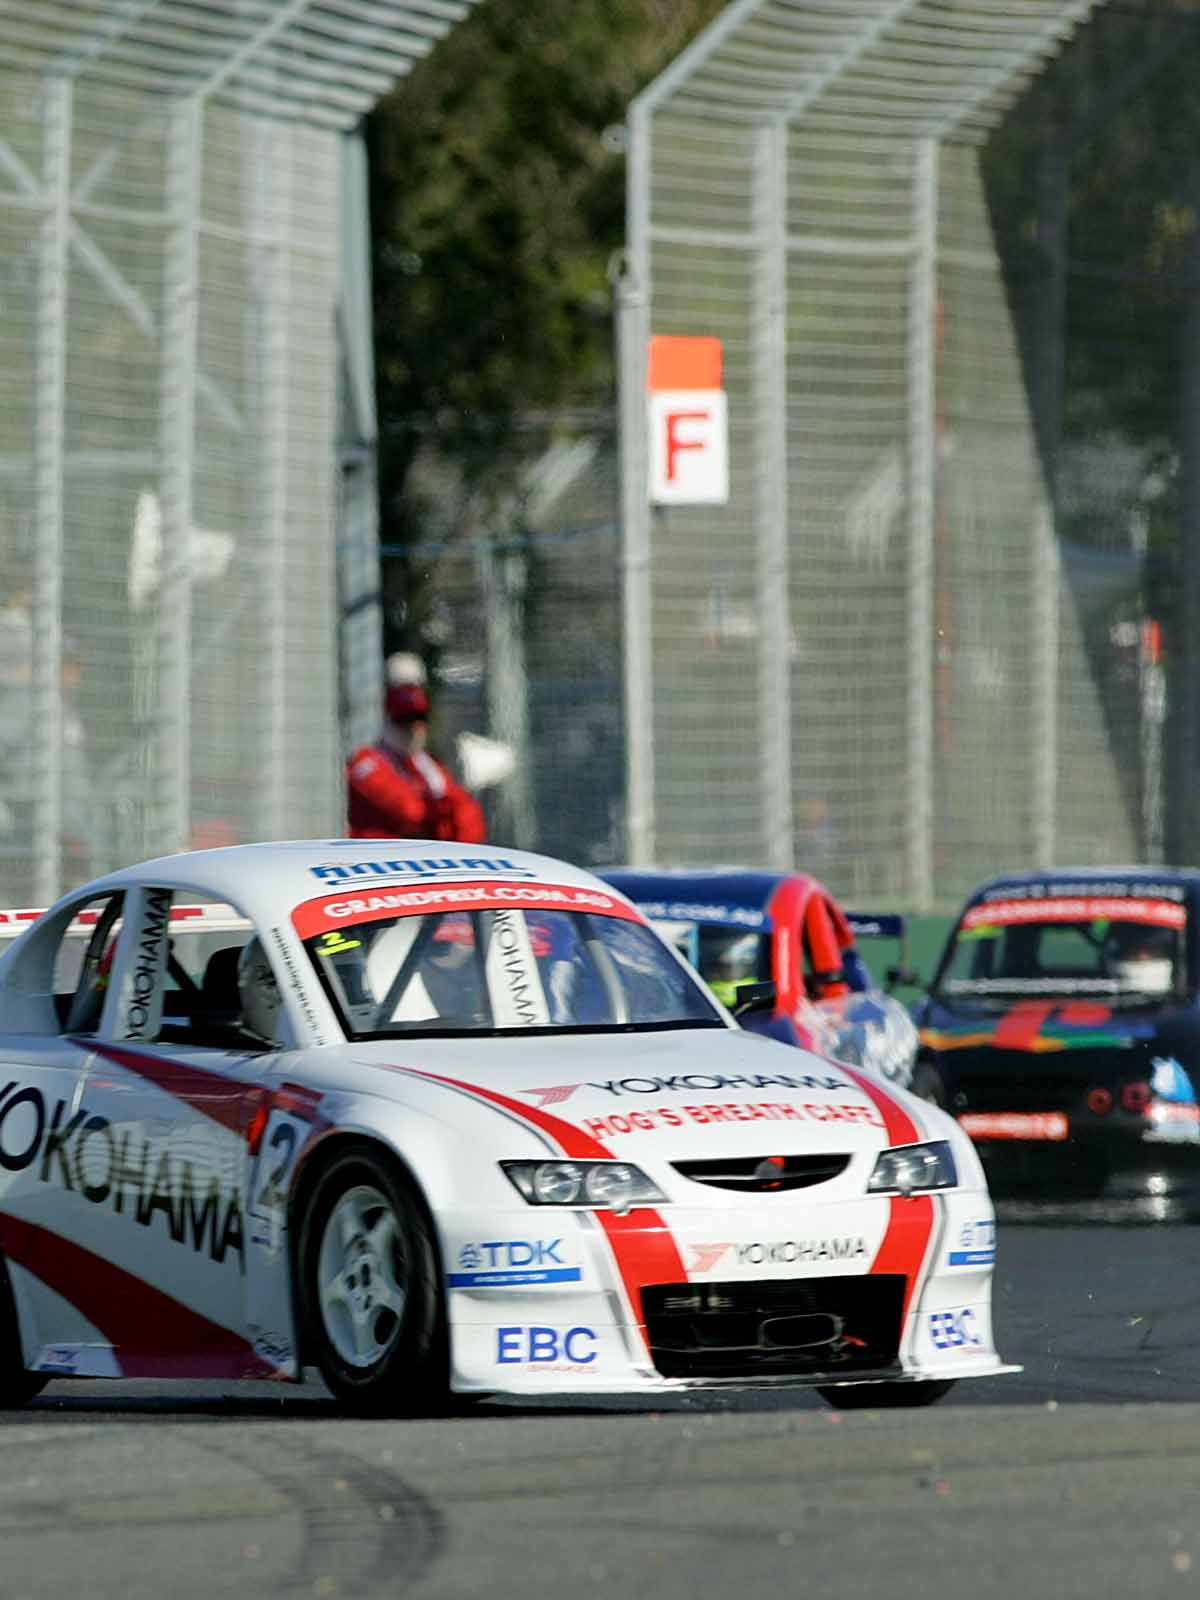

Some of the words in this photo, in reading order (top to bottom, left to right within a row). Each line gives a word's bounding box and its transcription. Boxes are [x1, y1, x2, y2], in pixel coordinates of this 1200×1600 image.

[666, 412, 711, 481] F
[125, 893, 168, 1039] YOKOHAMA
[491, 911, 538, 1025] KOHAMA
[585, 1074, 853, 1097] YOKOHAMA
[583, 1106, 684, 1140] HOG'S
[681, 1103, 804, 1125] BREATH
[802, 1103, 886, 1128] CAFE
[480, 1238, 565, 1267] TDK
[735, 1236, 867, 1265] YOKOHAMA
[497, 1326, 598, 1364] EBC
[930, 1309, 982, 1350] EBC
